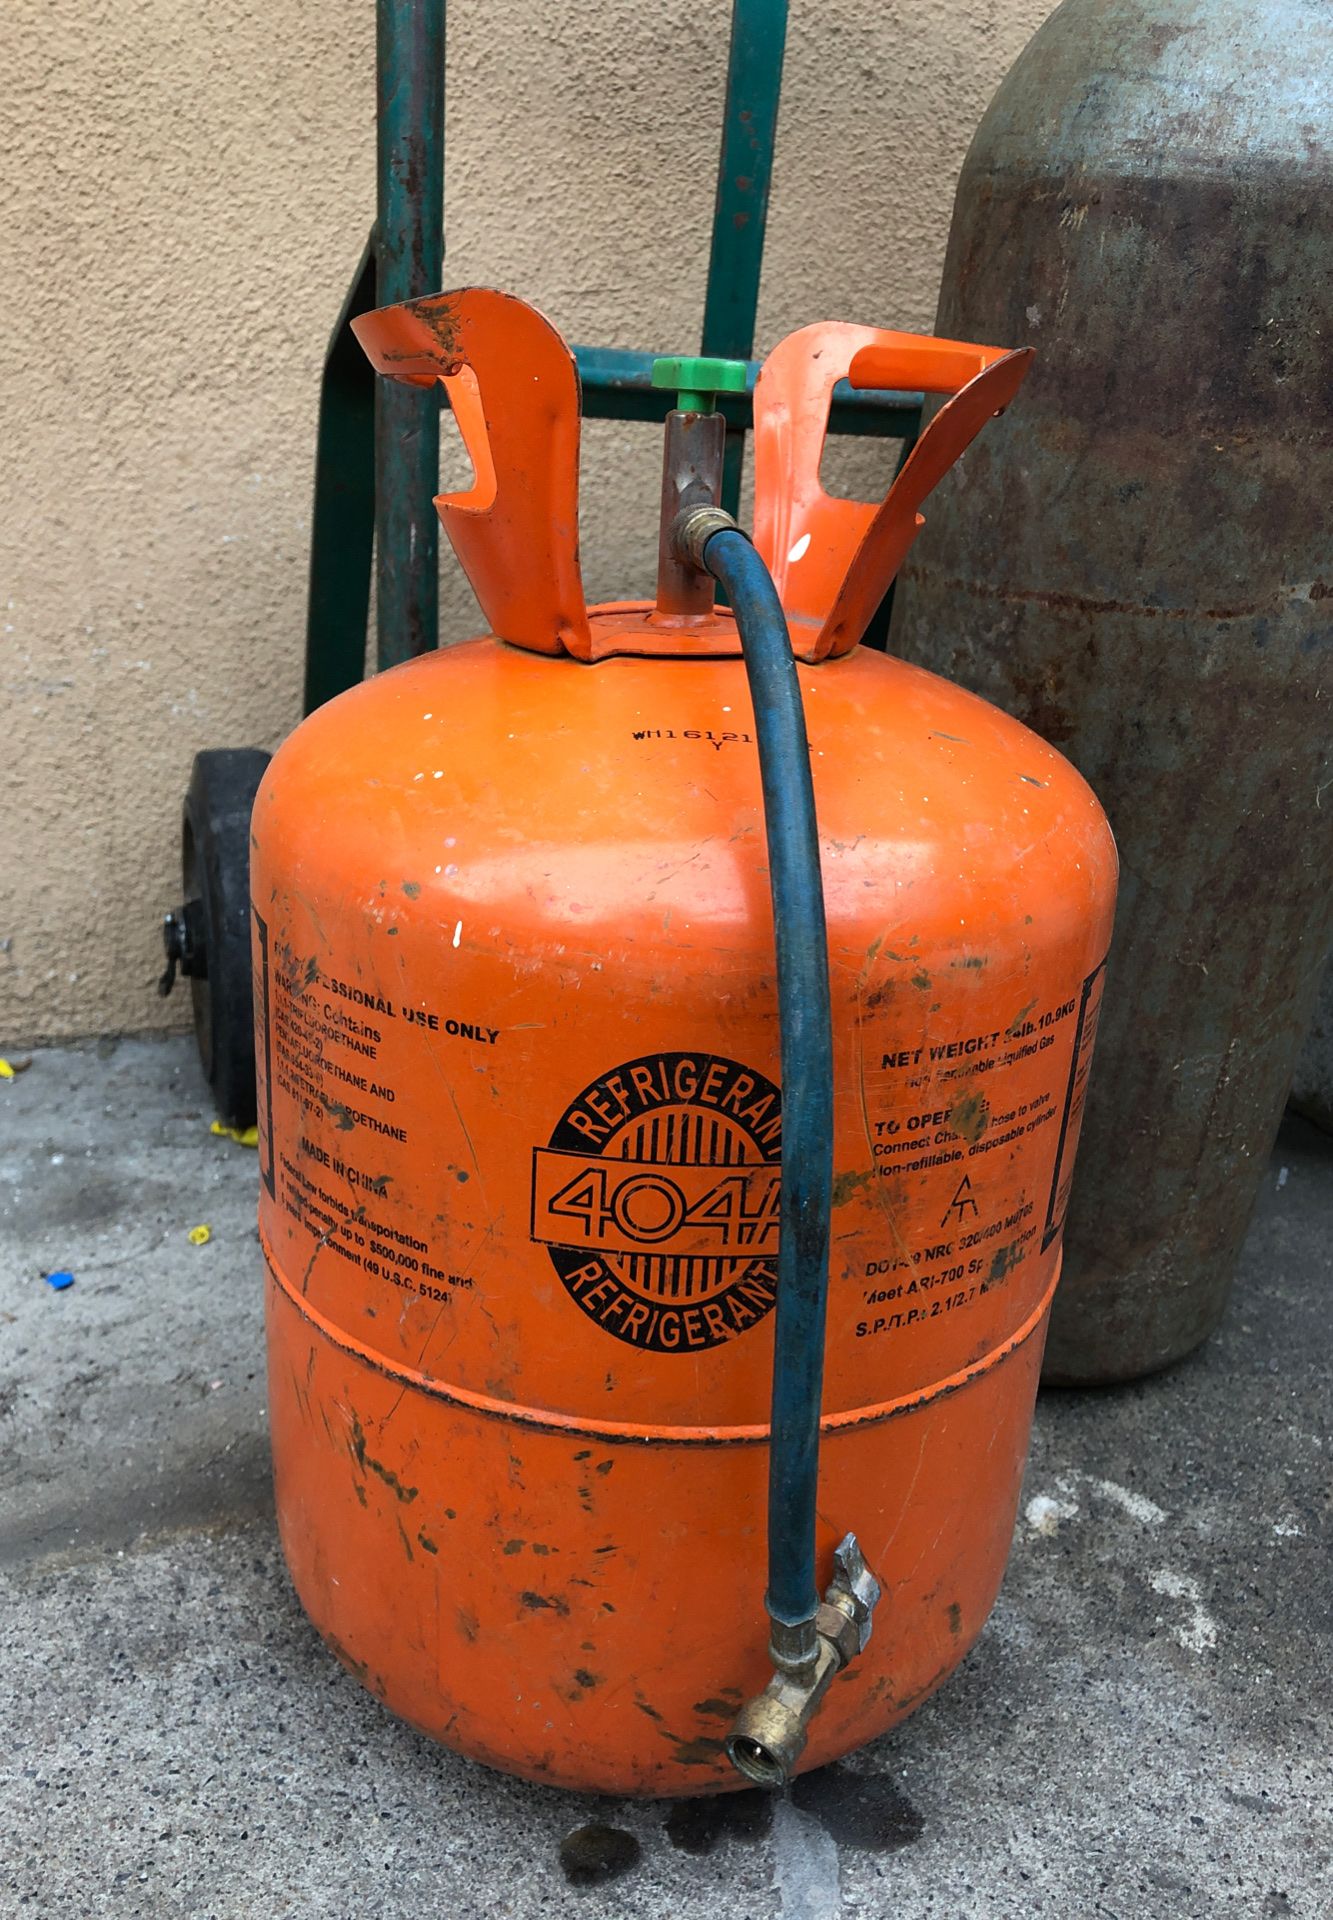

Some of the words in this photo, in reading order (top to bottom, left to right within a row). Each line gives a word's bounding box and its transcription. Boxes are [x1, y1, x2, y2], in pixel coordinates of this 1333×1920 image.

[275, 969, 321, 1010] WARNG:
[323, 1003, 382, 1043] Contains
[402, 1007, 439, 1031] USE
[445, 1019, 500, 1044] ONLY
[881, 1048, 923, 1070] NET
[929, 1032, 1001, 1063] WEIGHT
[1039, 1034, 1055, 1050] Gas
[370, 1083, 396, 1103] AND
[567, 1058, 782, 1156] REFRIGERAN
[874, 1119, 900, 1137] TO
[906, 1099, 990, 1132] OPEE:
[873, 1136, 931, 1156] Connect
[1018, 1105, 1027, 1117] to
[1030, 1092, 1051, 1111] valve
[968, 1126, 1025, 1157] disposable
[1026, 1105, 1057, 1132] cylinder
[301, 1136, 330, 1169] MADE
[333, 1158, 344, 1178] IN
[347, 1166, 388, 1199] CHINA
[304, 1215, 361, 1267] impronment
[363, 1257, 379, 1276] (49
[319, 1187, 348, 1217] forbids
[351, 1208, 428, 1254] tansportation
[340, 1225, 353, 1241] up
[354, 1232, 365, 1247] to
[370, 1240, 419, 1272] $500,000
[421, 1262, 445, 1281] fine
[448, 1274, 473, 1290] and
[866, 1252, 921, 1276] DO-9
[564, 1260, 779, 1348] REFRIGERANT
